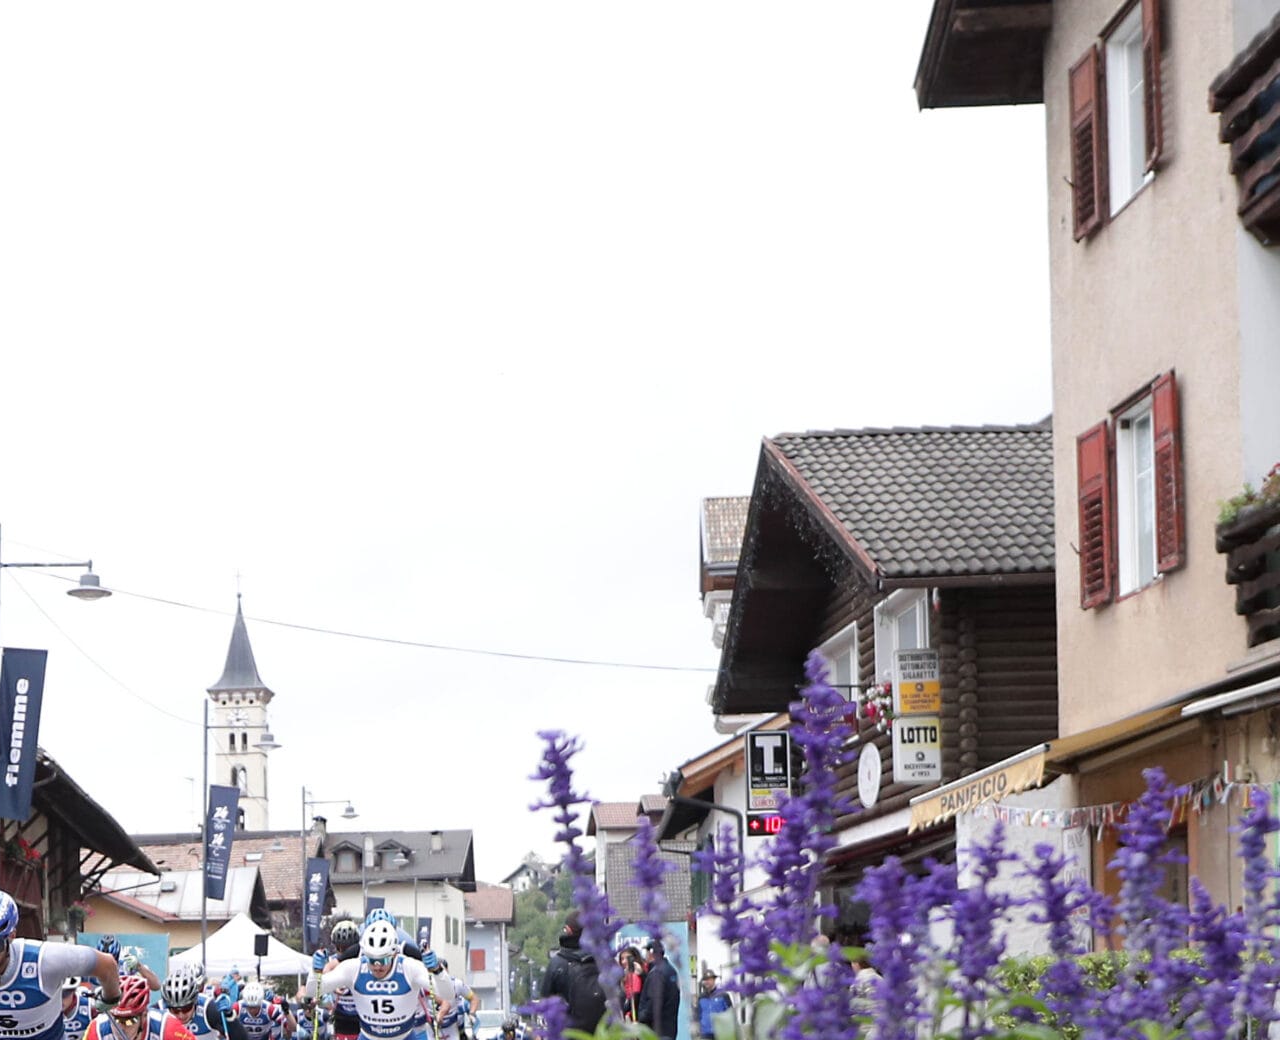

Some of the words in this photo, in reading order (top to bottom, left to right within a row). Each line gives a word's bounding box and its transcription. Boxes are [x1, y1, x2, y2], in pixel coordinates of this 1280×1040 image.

[6, 678, 29, 787] fiemme
[901, 726, 937, 744] LOTTO
[940, 772, 1008, 813] PANIFICIO
[366, 980, 399, 994] coop
[371, 999, 395, 1014] 15
